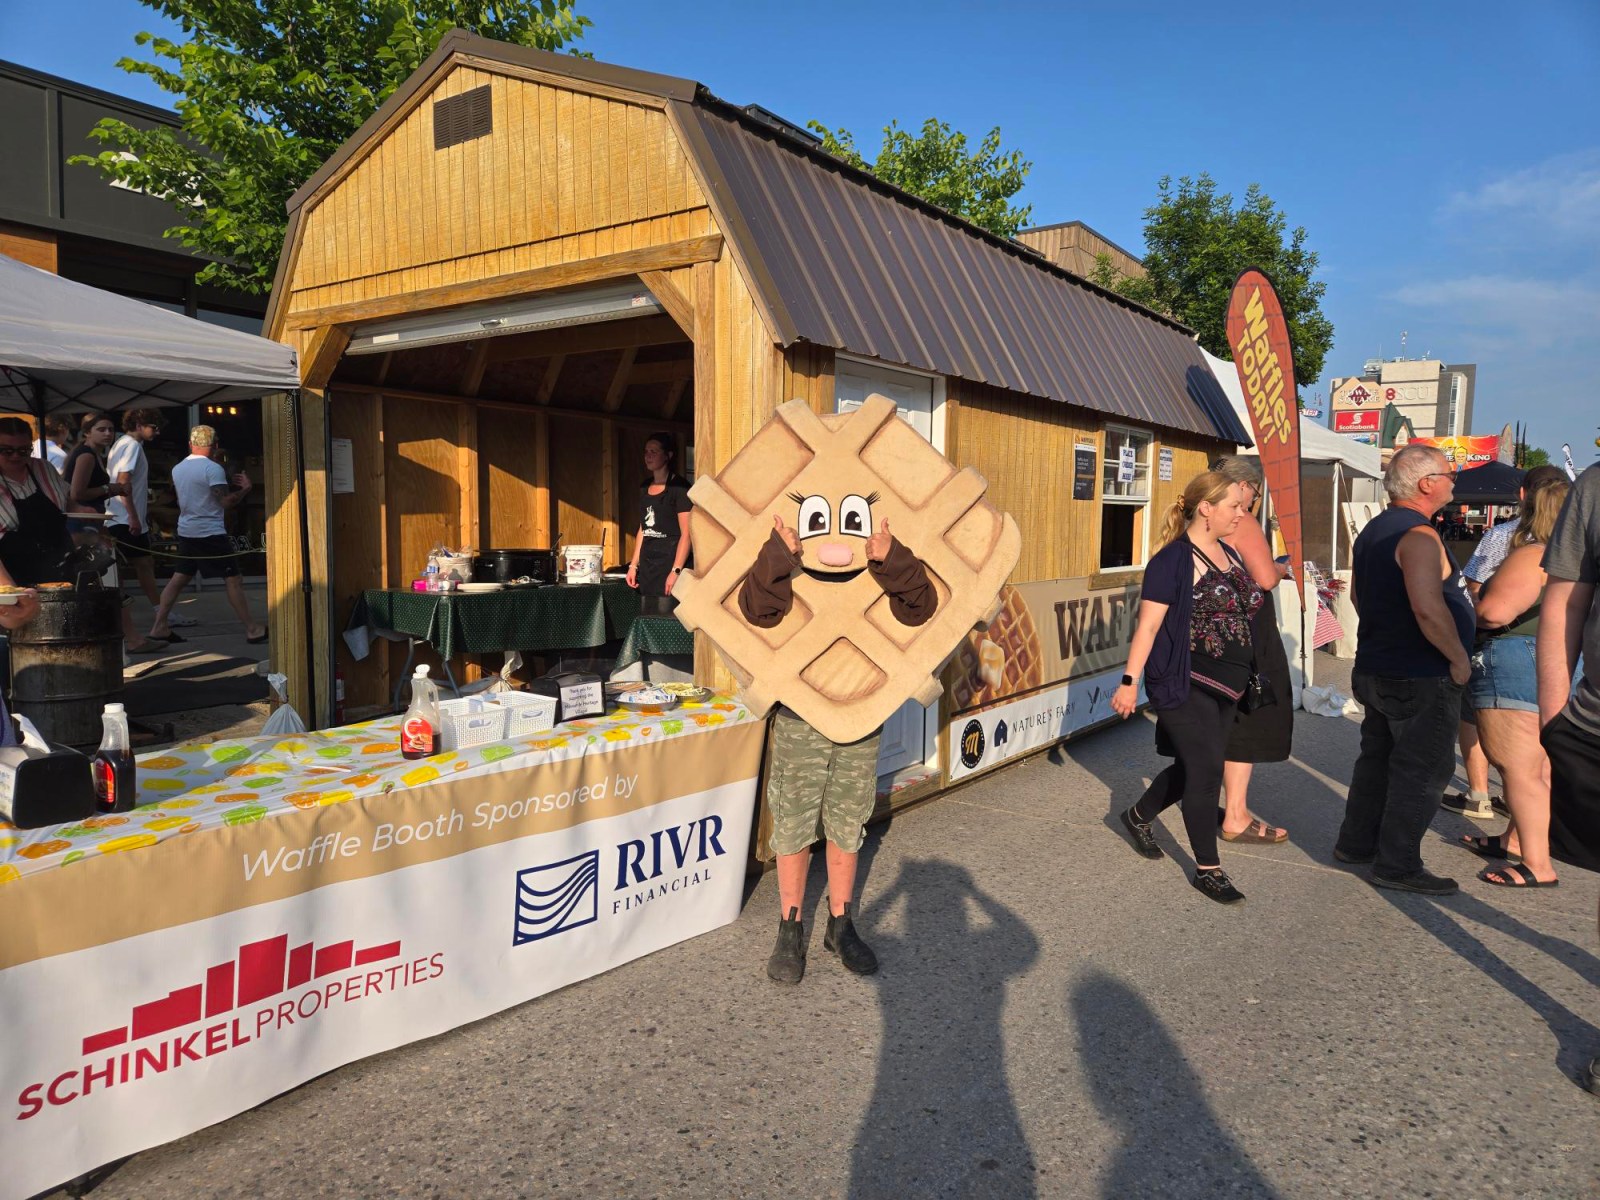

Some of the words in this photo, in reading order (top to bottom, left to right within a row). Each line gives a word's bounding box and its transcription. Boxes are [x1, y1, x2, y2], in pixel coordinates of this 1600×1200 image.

[1237, 328, 1277, 444] TODAY!
[1244, 285, 1292, 444] Waffles
[1396, 386, 1430, 400] SCU
[242, 831, 361, 881] Waffle
[371, 806, 464, 853] Booth
[471, 774, 608, 830] Sponsored
[614, 772, 639, 800] by
[613, 814, 727, 892] RIVR
[612, 868, 713, 915] FINANCIAL
